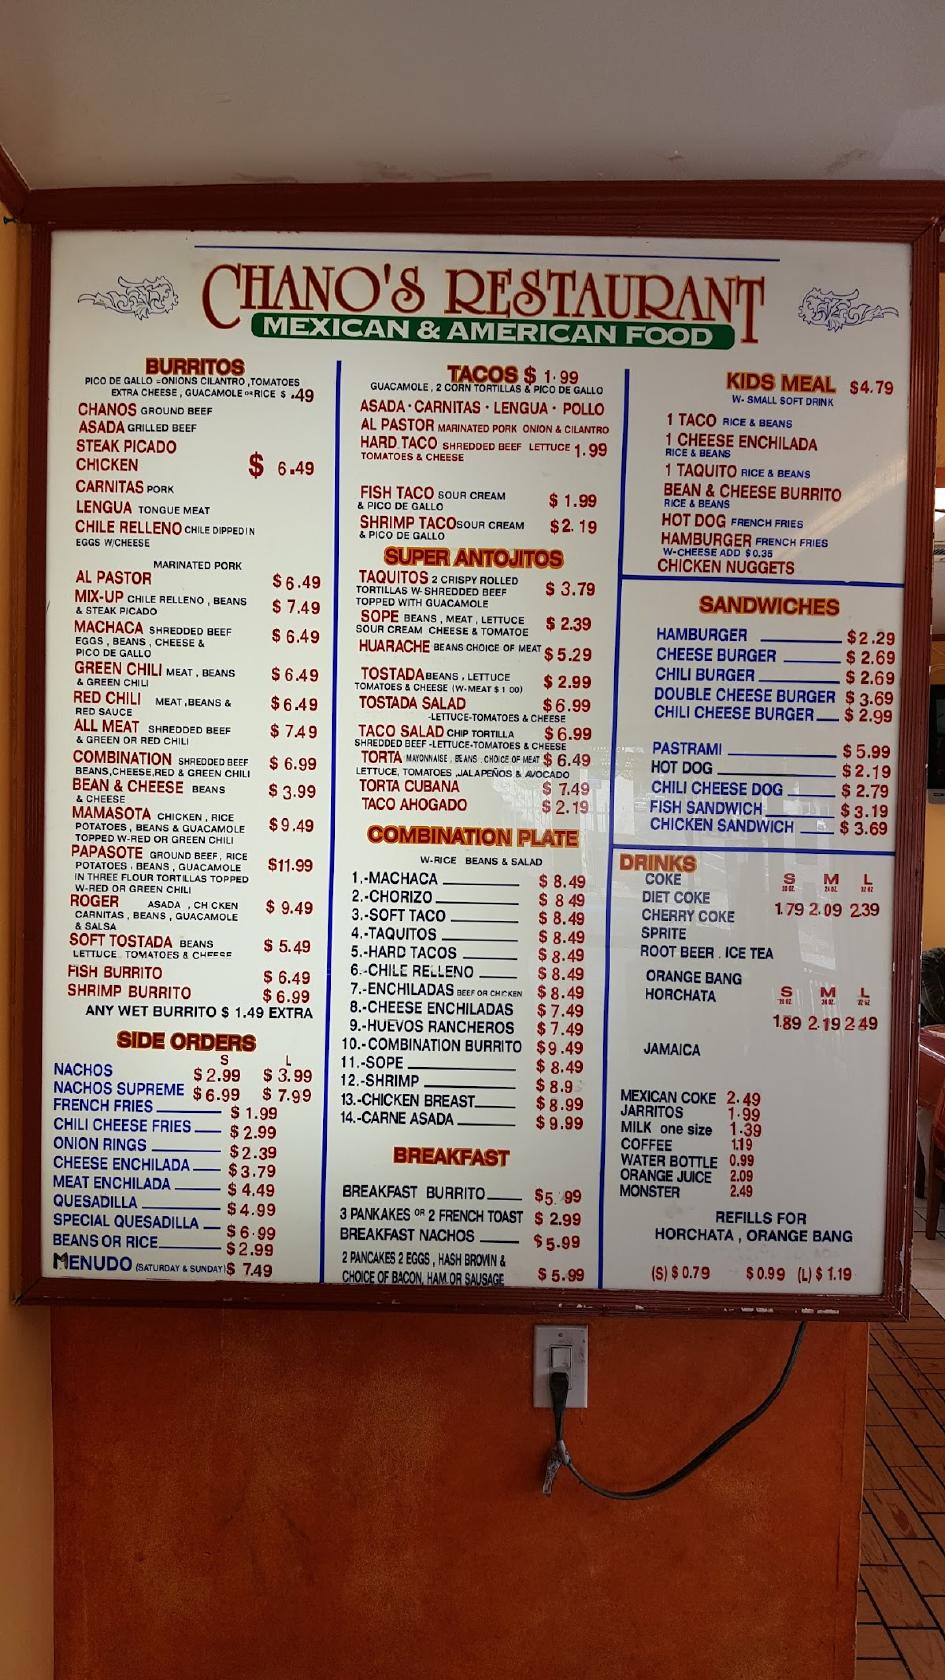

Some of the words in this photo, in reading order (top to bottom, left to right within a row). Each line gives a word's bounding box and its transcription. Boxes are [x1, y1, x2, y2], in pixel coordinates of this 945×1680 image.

[203, 263, 425, 329] CHANO'S
[444, 268, 765, 344] RESTAURANT
[264, 317, 409, 338] MEXICAN
[417, 321, 440, 339] &
[447, 322, 616, 343] AMERICAN
[627, 326, 712, 345] FOOD
[146, 358, 245, 376] BURRITOS
[448, 365, 518, 383] TACOS
[85, 377, 106, 385] PICO
[726, 371, 776, 392] KIDS
[781, 373, 837, 394] MEAL
[850, 380, 893, 395] $4.79
[747, 395, 777, 404] SMALL
[780, 397, 803, 405] SOFT
[806, 398, 834, 406] DRINK
[78, 402, 136, 416] CHANOS
[141, 407, 184, 415] GROUND
[188, 407, 212, 415] BEEF
[79, 420, 125, 434] ASADA
[128, 424, 169, 432] GRILLED
[172, 424, 197, 432] BEEF
[668, 413, 672, 425] 1
[679, 413, 717, 427] TACO
[723, 418, 746, 426] RICE
[749, 419, 755, 427] &
[759, 419, 792, 428] BEANS
[76, 439, 120, 452] STEAK
[124, 440, 176, 454] PICADO
[361, 436, 397, 448] HARD
[401, 436, 437, 450] TACO
[443, 442, 495, 450] SHREDDED
[498, 443, 522, 451] BEEF
[678, 433, 734, 447] CHEESE
[739, 435, 817, 451] ENCHILADA
[76, 458, 138, 471] CHICKEN
[677, 463, 737, 478] TAQUITO
[76, 480, 144, 494] CARNITAS
[147, 485, 174, 493] PORK
[361, 485, 391, 499] FISH
[396, 486, 434, 500] TACO
[438, 491, 466, 499] SOUR
[470, 492, 505, 500] CREAM
[664, 483, 701, 496] BEAN
[706, 484, 715, 497] &
[720, 484, 776, 499] CHEESE
[781, 486, 841, 502] BURRITO
[77, 500, 132, 514] LENGUA
[138, 506, 180, 514] TONGUE
[75, 520, 115, 533] CHILE
[120, 521, 182, 535] RELLENO
[662, 513, 691, 527] HOT
[695, 514, 726, 528] DOG
[731, 518, 772, 527] FRENCH
[775, 520, 803, 528] FRIES
[661, 532, 752, 547] HAMBURGER
[154, 561, 211, 569] MARINATED
[215, 562, 242, 570] PORK
[384, 547, 449, 566] SUPER
[452, 547, 564, 569] ANTOJITOS
[658, 558, 721, 573] CHICKEN
[726, 560, 794, 575] NUGGETS
[76, 570, 92, 583] AL
[97, 570, 151, 585] PASTOR
[359, 570, 428, 584] TAQUITOS
[356, 598, 395, 606] TOPPED
[398, 598, 422, 606] WITH
[426, 599, 488, 608] GUACAMOLE
[699, 595, 840, 617] SANDWICHES
[361, 609, 399, 623] SOPE
[75, 620, 143, 634] MACHACA
[149, 626, 203, 635] SHREDDED
[207, 628, 232, 636] BEEF
[657, 627, 747, 641] HAMBURGER
[360, 639, 430, 653] HUARACHE
[657, 647, 713, 661] CHEESE
[717, 648, 776, 662] BURGER
[75, 661, 121, 675] GREEN
[127, 662, 162, 676] CHILI
[359, 695, 417, 709] TOSTADA
[422, 696, 466, 710] SALAD
[653, 741, 721, 755] PASTRAMI
[73, 750, 172, 765] COMBINATION
[362, 797, 395, 810] TACO
[400, 798, 467, 811] AHOGADO
[72, 806, 151, 820] MAMASOTA
[367, 825, 513, 847] COMBINATION
[517, 828, 579, 848] PLATE
[72, 844, 143, 859] PAPASOTE
[466, 857, 498, 865] BEANS
[511, 858, 542, 866] SALAD
[620, 853, 697, 873] DRINKS
[645, 873, 681, 885] COKE
[71, 894, 119, 907] ROGER
[409, 909, 446, 922] TACO
[69, 933, 105, 946] SOFT
[109, 934, 173, 948] TOSTADA
[180, 940, 213, 948] BEANS
[641, 926, 686, 940] SPRITE
[68, 964, 98, 978] FISH
[104, 966, 162, 979] BURRITO
[646, 969, 701, 983] ORANGE
[705, 972, 742, 985] BANG
[646, 988, 716, 1002] HORCHATA
[85, 1005, 114, 1016] ANY
[118, 1005, 148, 1016] WET
[153, 1006, 216, 1018] BURRITO
[269, 1007, 313, 1019] EXTRA
[427, 1002, 513, 1016] ENCHILADAS
[116, 1030, 165, 1049] SIDE
[170, 1032, 256, 1052] ORDERS
[643, 1042, 700, 1056] JAMAICA
[54, 1063, 113, 1077] NACHOS
[54, 1081, 112, 1095] NACHOS
[117, 1082, 184, 1096] SUPREME
[621, 1089, 677, 1103] MEXICAN
[681, 1092, 716, 1104] COKE
[54, 1098, 109, 1111] FRENCH
[114, 1099, 153, 1113] FRIES
[620, 1104, 683, 1119] JARRITOS
[621, 1121, 651, 1133] MILK
[660, 1125, 683, 1135] one
[688, 1123, 712, 1136] size
[54, 1136, 98, 1150] ONION
[103, 1138, 146, 1151] RINGS
[621, 1137, 672, 1151] COFFEE
[393, 1147, 510, 1167] BREAKFAST
[621, 1153, 665, 1167] WATER
[670, 1155, 718, 1169] BOTTLE
[730, 1154, 754, 1167] 0.99
[620, 1168, 673, 1182] ORANGE
[677, 1170, 712, 1184] JUICE
[730, 1170, 753, 1182] 2.09
[343, 1185, 418, 1199] BREAKFAST
[427, 1186, 485, 1200] BURRITO
[620, 1184, 680, 1198] MONSTER
[730, 1184, 753, 1197] 2.49
[54, 1194, 138, 1208] QUESADILLA
[716, 1211, 772, 1224] REFILLS
[777, 1212, 806, 1225] FOR
[53, 1233, 98, 1247] BEANS
[102, 1235, 121, 1248] OR
[126, 1236, 158, 1248] RICE
[53, 1252, 132, 1271] MENUDO
